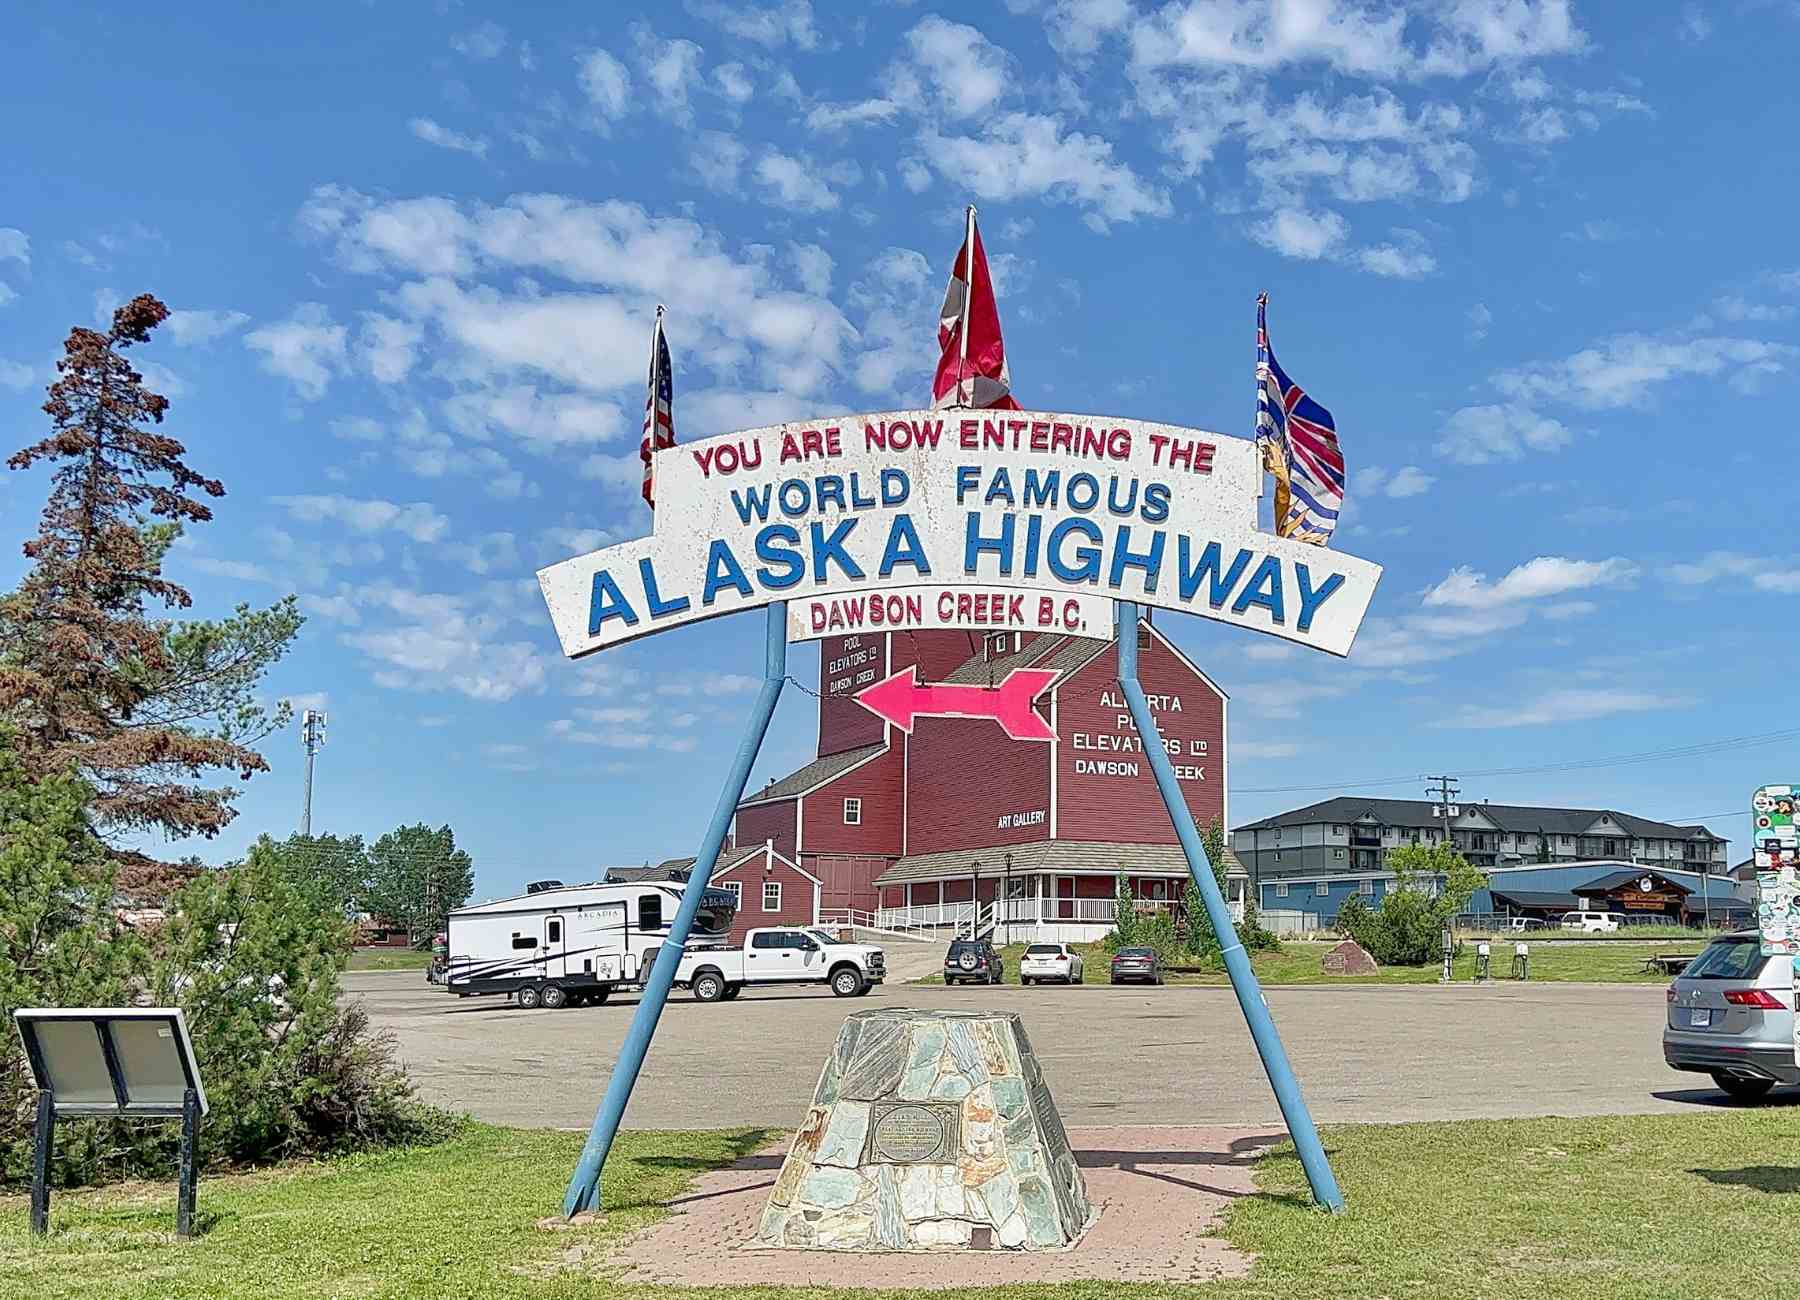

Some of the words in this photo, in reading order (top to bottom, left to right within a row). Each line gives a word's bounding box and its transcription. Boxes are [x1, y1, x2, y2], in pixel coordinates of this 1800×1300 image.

[693, 438, 762, 478] YOU
[780, 427, 842, 465] ARE
[864, 420, 943, 453] NOW
[959, 419, 1132, 462] ENTERING
[1149, 434, 1217, 474] THE
[730, 467, 911, 525] WORLD
[956, 466, 1171, 524] FAMOUS
[588, 514, 932, 638] ALASKA
[964, 511, 1346, 634] HIGHWAY
[811, 594, 922, 633] DAWSON
[937, 591, 1024, 625] CREEK
[1037, 596, 1087, 632] B.C.
[844, 635, 862, 652] POOL
[829, 650, 867, 675] ELEVATORS
[830, 676, 852, 693] DAWSON
[856, 668, 876, 685] CREEK
[1099, 691, 1183, 712] ALRTA
[1072, 733, 1181, 755] ELEVATRS
[1075, 760, 1139, 777] DAWSON
[1171, 765, 1205, 780] EEK
[997, 815, 1012, 829] ART
[1013, 810, 1046, 827] GALLERY
